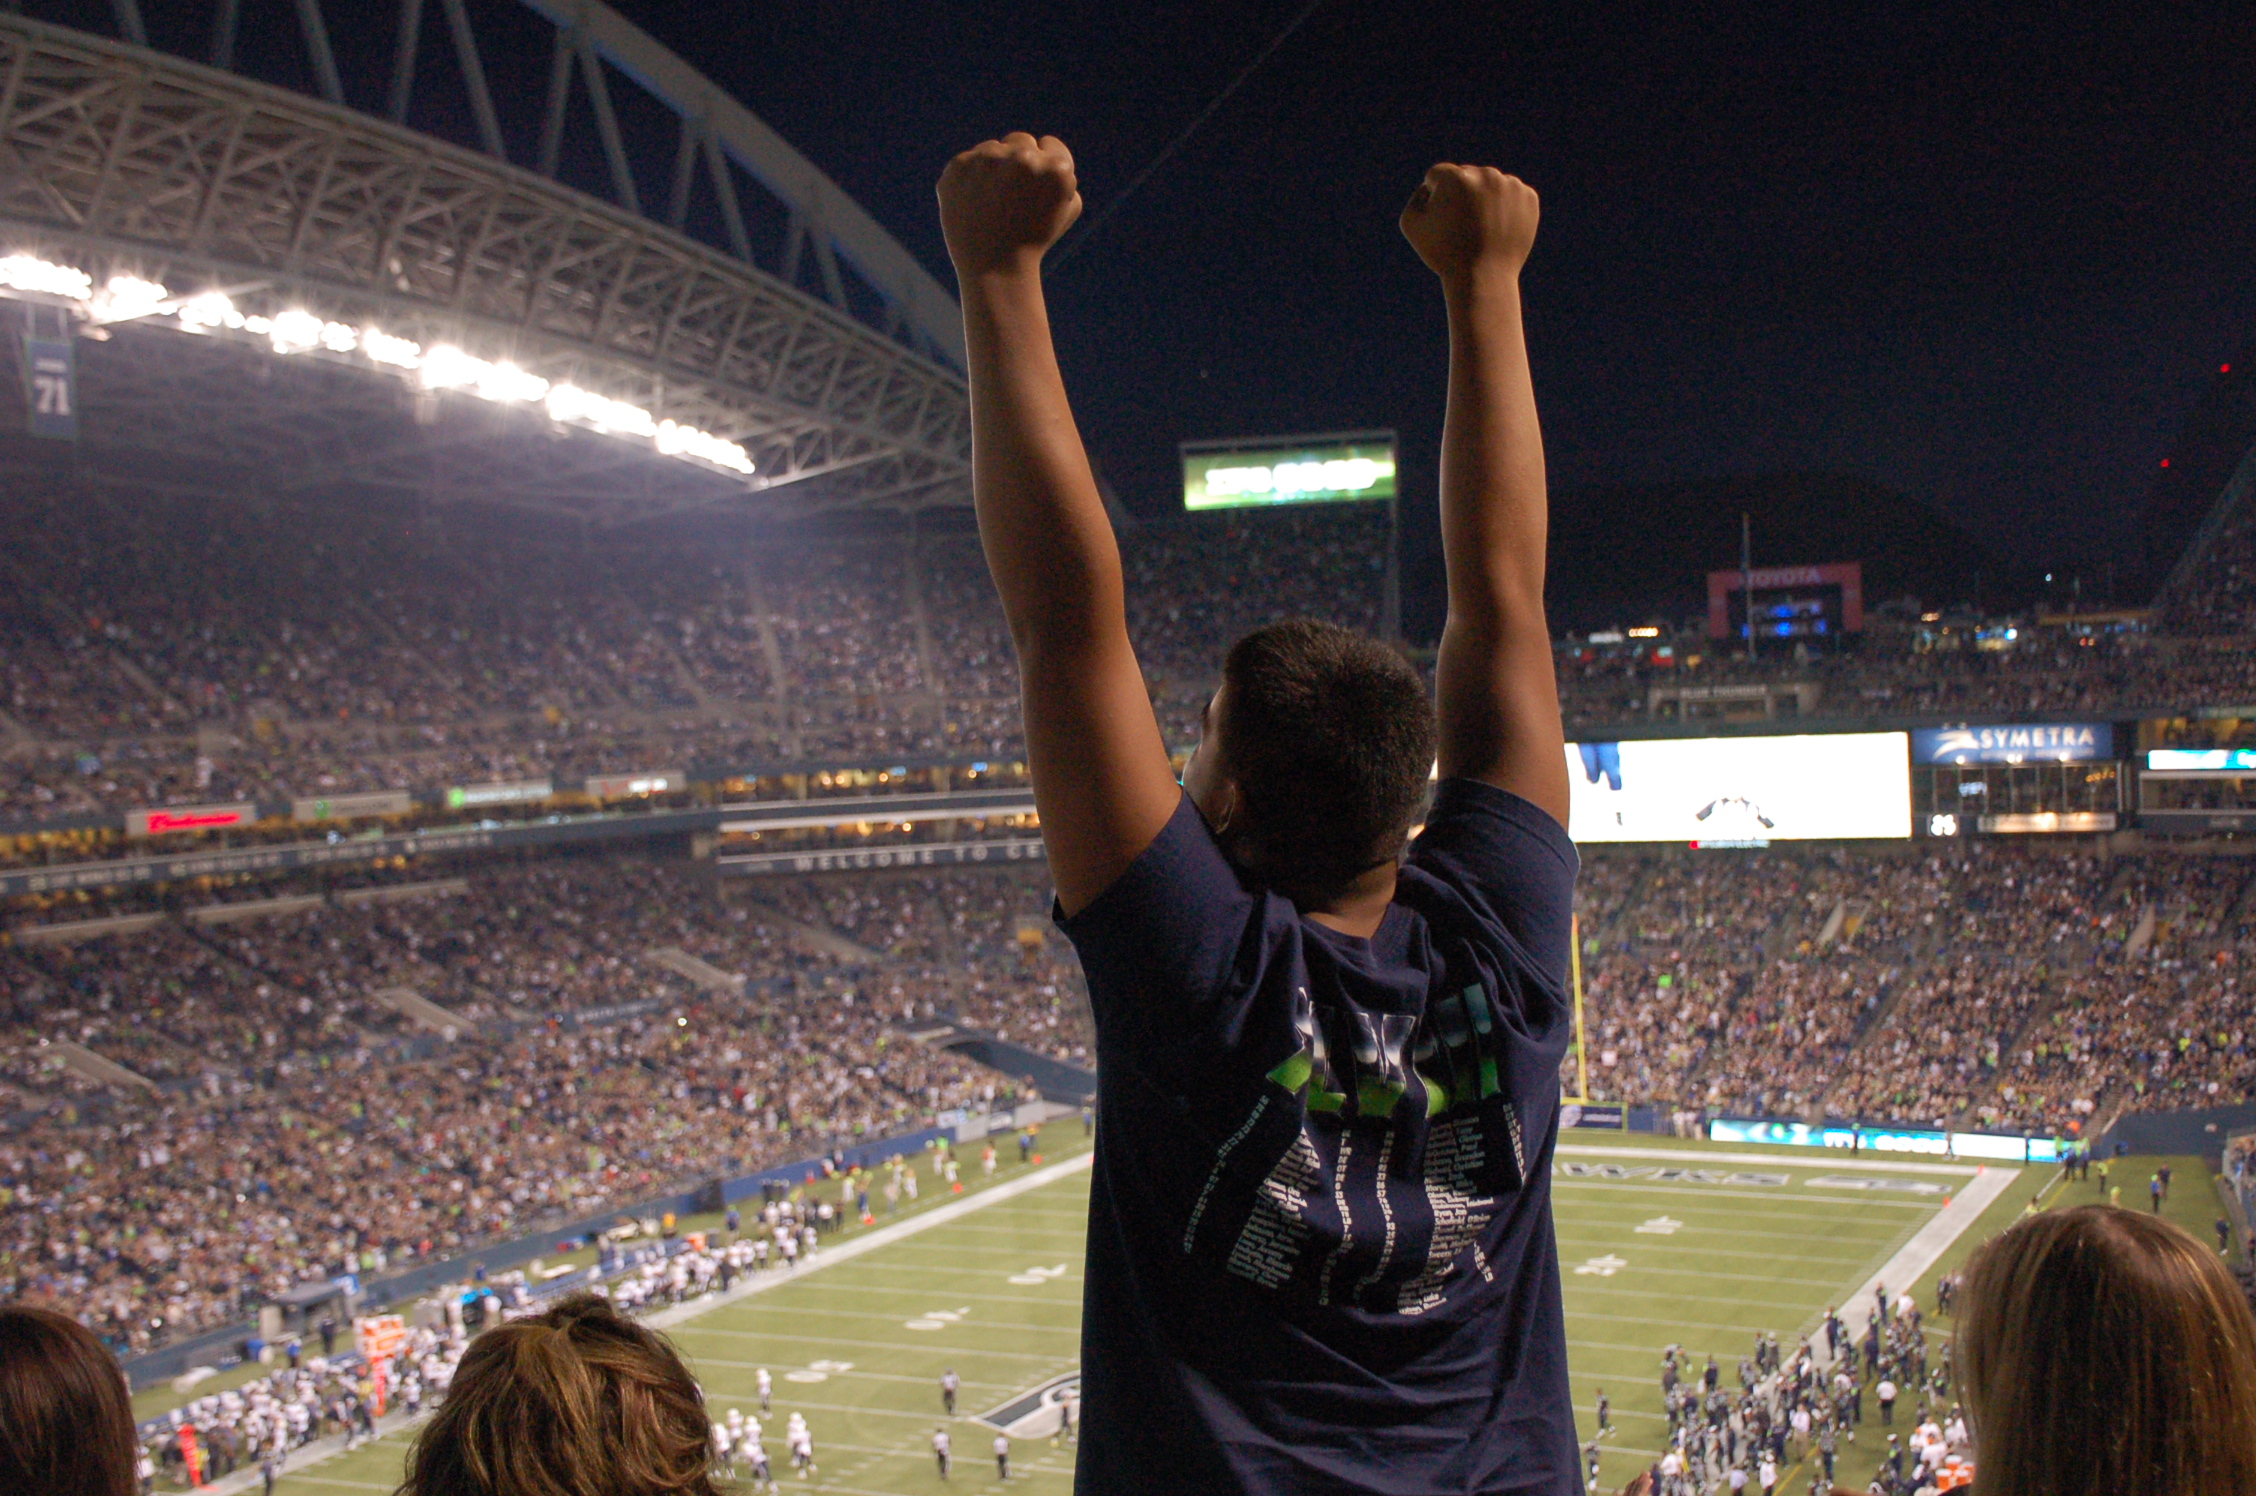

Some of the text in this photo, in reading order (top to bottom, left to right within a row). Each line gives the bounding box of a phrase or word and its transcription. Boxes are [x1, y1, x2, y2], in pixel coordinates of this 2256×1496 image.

[34, 375, 71, 416] 71
[1979, 727, 2094, 749] SYMETRA
[794, 849, 934, 870] WELCOME
[955, 845, 988, 861] TO
